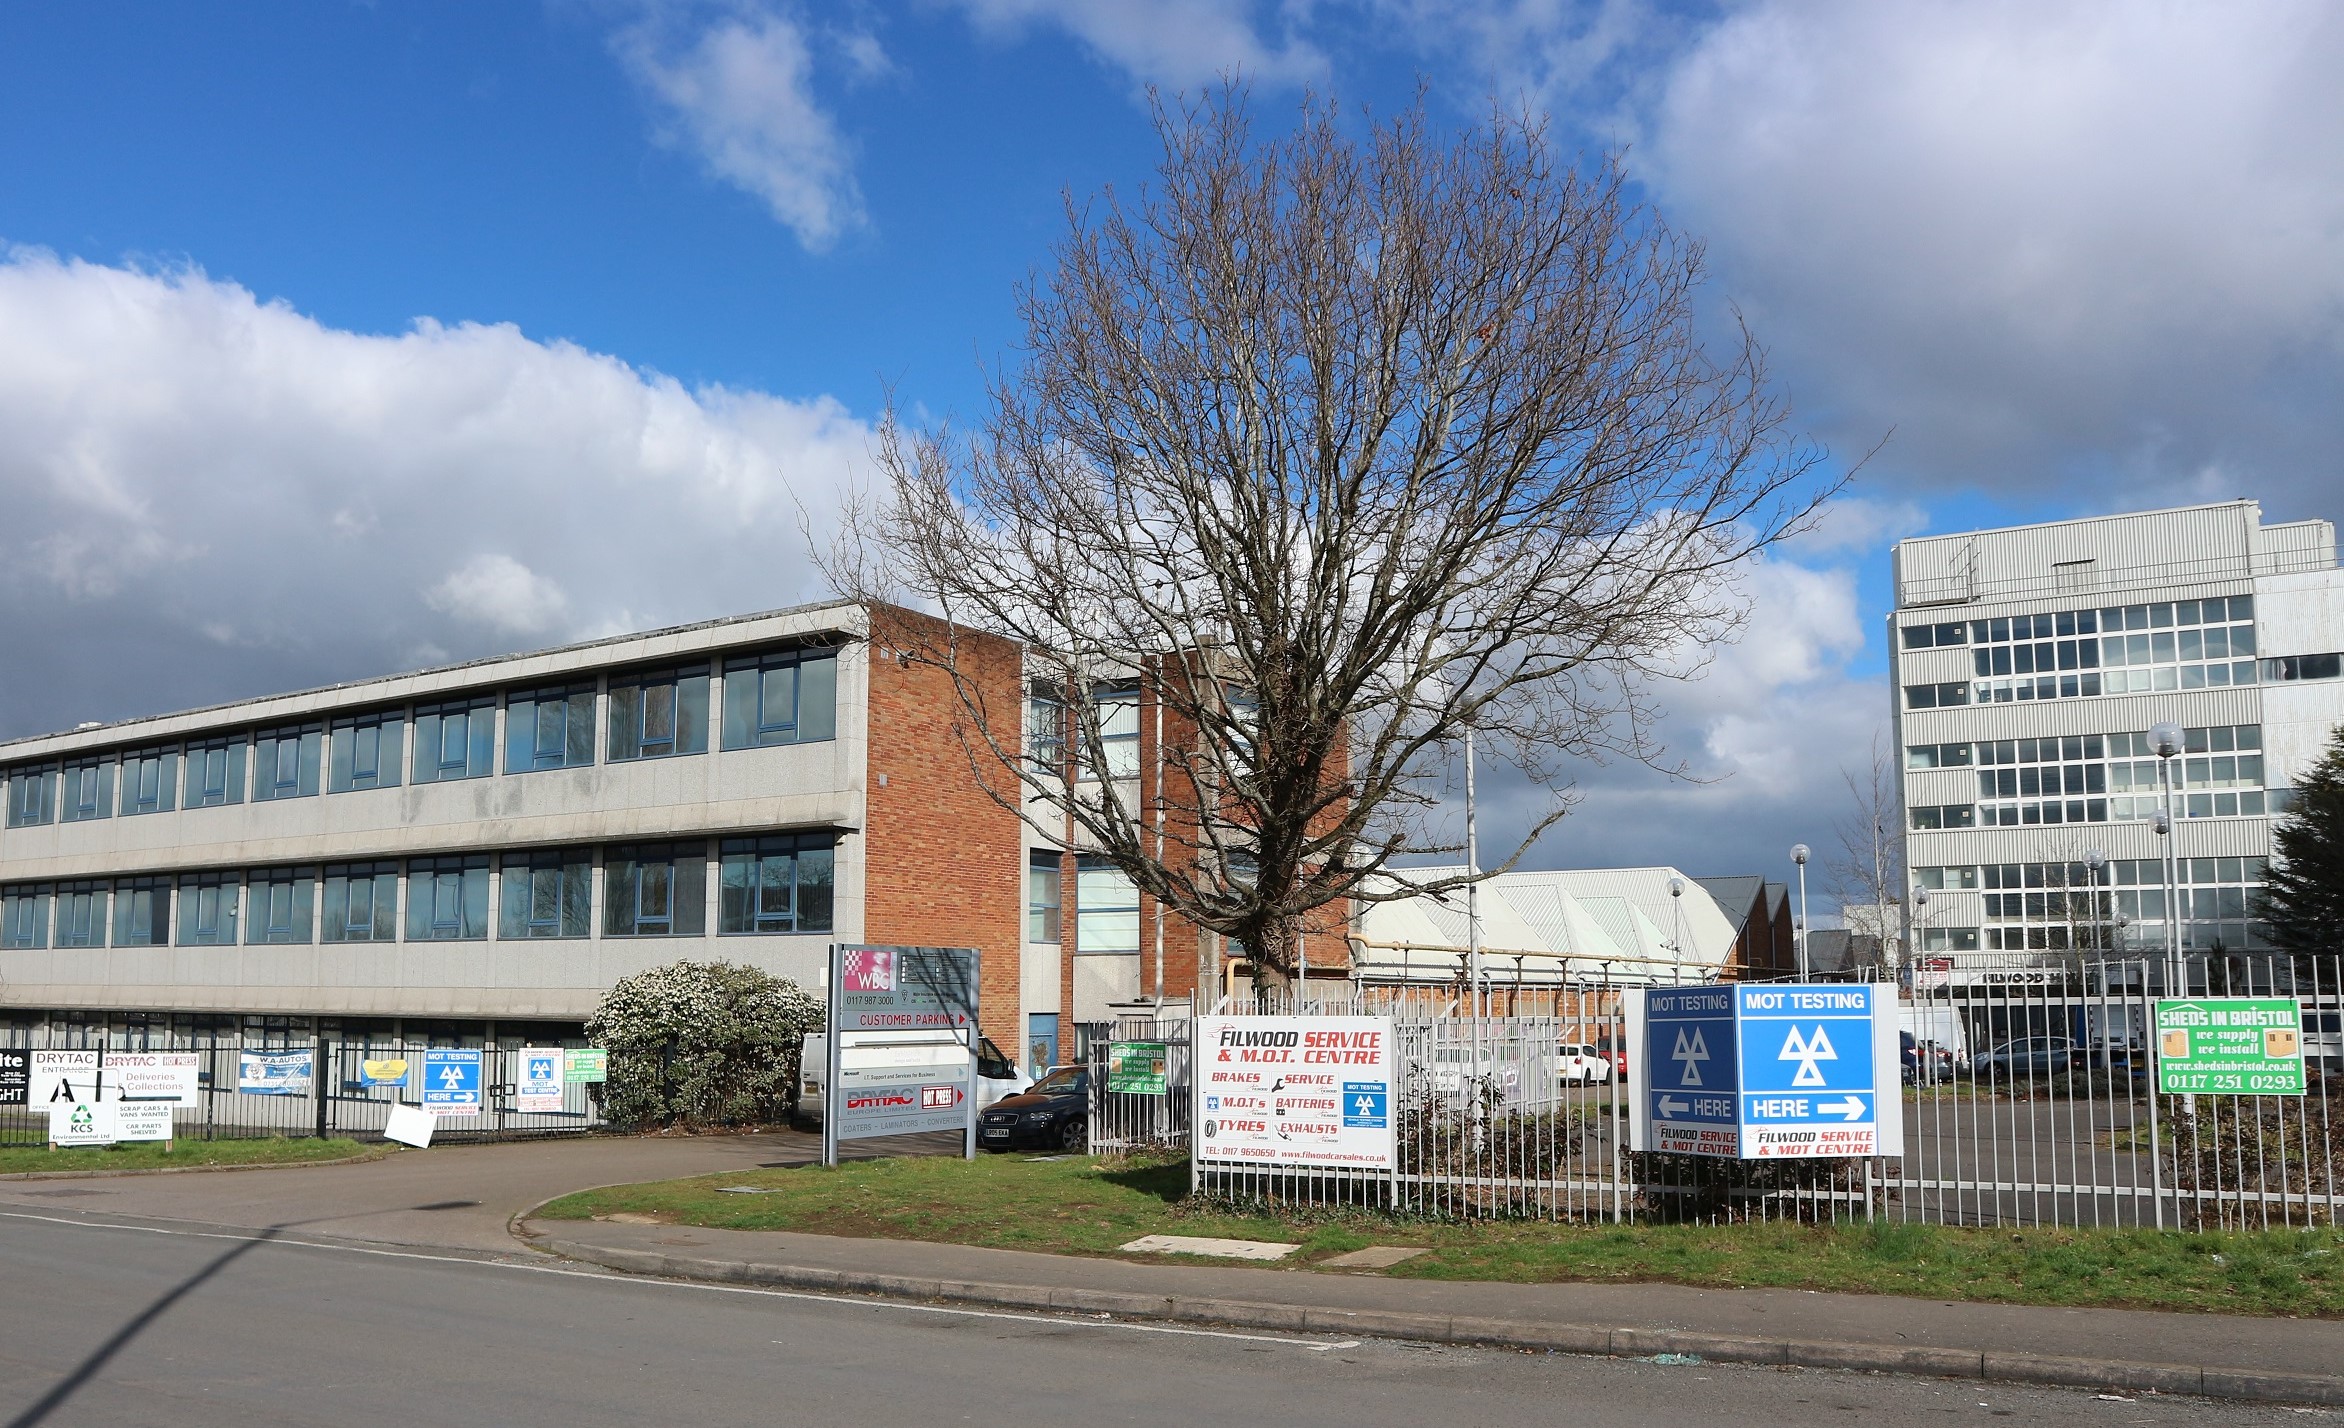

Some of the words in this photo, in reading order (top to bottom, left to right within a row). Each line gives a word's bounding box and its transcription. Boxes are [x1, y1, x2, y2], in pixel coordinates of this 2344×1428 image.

[858, 972, 889, 990] WBC
[846, 996, 862, 1005] 0117
[865, 996, 877, 1006] 987
[879, 996, 894, 1006] 3000
[1652, 997, 1675, 1012] MOT
[1679, 995, 1728, 1011] TESTING
[1746, 993, 1785, 1009] MOT
[1790, 993, 1865, 1009] TESTING
[860, 1014, 912, 1026] CUSTOMER
[916, 1013, 955, 1025] PARKING
[2160, 1011, 2208, 1026] SHEDS
[2212, 1011, 2227, 1026] IN
[2230, 1009, 2296, 1026] BRISTOL
[1219, 1031, 1299, 1047] FILWOOD
[1304, 1032, 1381, 1048] SERVICE
[2196, 1031, 2213, 1040] we
[2217, 1030, 2258, 1042] supply
[1111, 1048, 1130, 1057] SHEDS
[1131, 1049, 1137, 1057] IN
[1138, 1048, 1164, 1058] BRISTOL
[2198, 1045, 2216, 1054] we
[2219, 1043, 2259, 1054] install
[36, 1053, 94, 1064] DRYTAC
[105, 1056, 156, 1067] DRYTAC
[178, 1057, 196, 1065] PRESS
[1217, 1049, 1232, 1062] &
[1240, 1050, 1295, 1063] M.O.T.
[1304, 1050, 1381, 1064] CENTRE
[2166, 1060, 2296, 1072] www.shedsinbristol.co.uk
[126, 1073, 175, 1081] Deliveries
[1212, 1072, 1261, 1083] BRAKES
[1284, 1074, 1334, 1084] SERVICE
[2167, 1074, 2208, 1089] 0117
[2213, 1074, 2243, 1089] 251
[2250, 1075, 2297, 1090] 0293
[127, 1082, 184, 1091] Collections
[1144, 1083, 1163, 1091] 0293
[427, 1093, 451, 1101] HERE
[847, 1088, 914, 1108] DRYTAC
[923, 1090, 934, 1105] HOT
[935, 1089, 951, 1105] PRESS
[1222, 1097, 1266, 1108] M.O.T's
[1275, 1098, 1335, 1109] BATTERIES
[1694, 1099, 1731, 1117] HERE
[1753, 1099, 1809, 1117] HERE
[70, 1124, 93, 1133] KCS
[843, 1123, 872, 1133] COATERS
[880, 1120, 919, 1130] LAMINATORS
[927, 1116, 963, 1126] CONVERTERS
[1219, 1119, 1266, 1132] TYRES
[1280, 1122, 1338, 1134] EXHAUSTS
[1660, 1127, 1697, 1140] FILWOOD
[1700, 1130, 1736, 1143] SERVICE
[1758, 1132, 1816, 1143] FILWOOD
[1821, 1130, 1873, 1141] SERVICE
[1661, 1140, 1668, 1150] &
[1672, 1141, 1695, 1152] MOT
[1697, 1142, 1736, 1155] CENTRE
[1758, 1145, 1770, 1155] &
[1777, 1144, 1808, 1155] MOT
[1815, 1143, 1872, 1154] CENTRE
[1205, 1146, 1220, 1155] TEL:
[1222, 1147, 1238, 1156] 0117
[1241, 1148, 1276, 1157] 9650650
[1281, 1151, 1387, 1163] www.filwoodcarsales.co.uk
